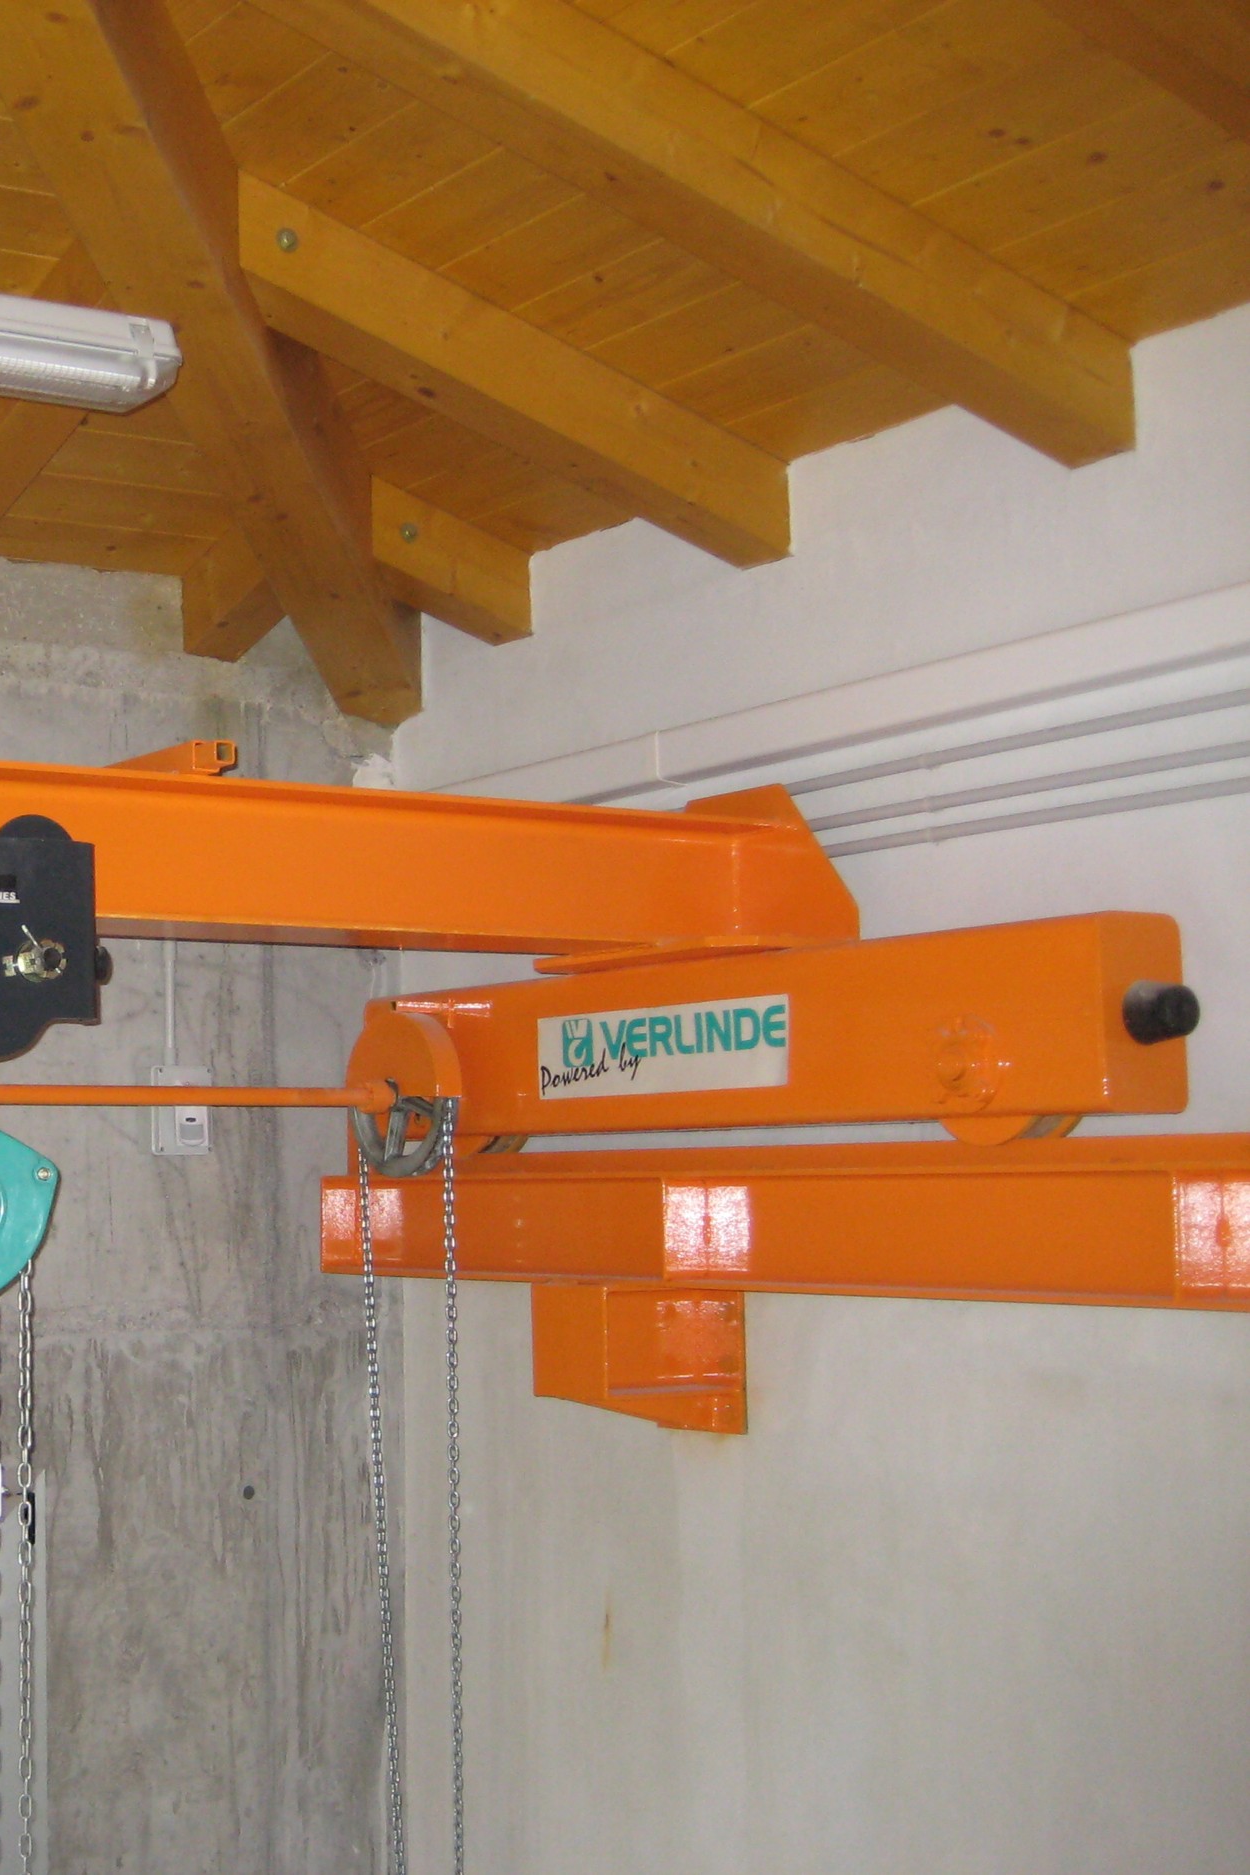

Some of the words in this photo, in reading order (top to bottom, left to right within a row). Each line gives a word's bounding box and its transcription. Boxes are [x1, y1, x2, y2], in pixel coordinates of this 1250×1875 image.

[599, 1004, 787, 1061] VERLINDE
[540, 1048, 610, 1096] Powered
[618, 1043, 642, 1081] by
